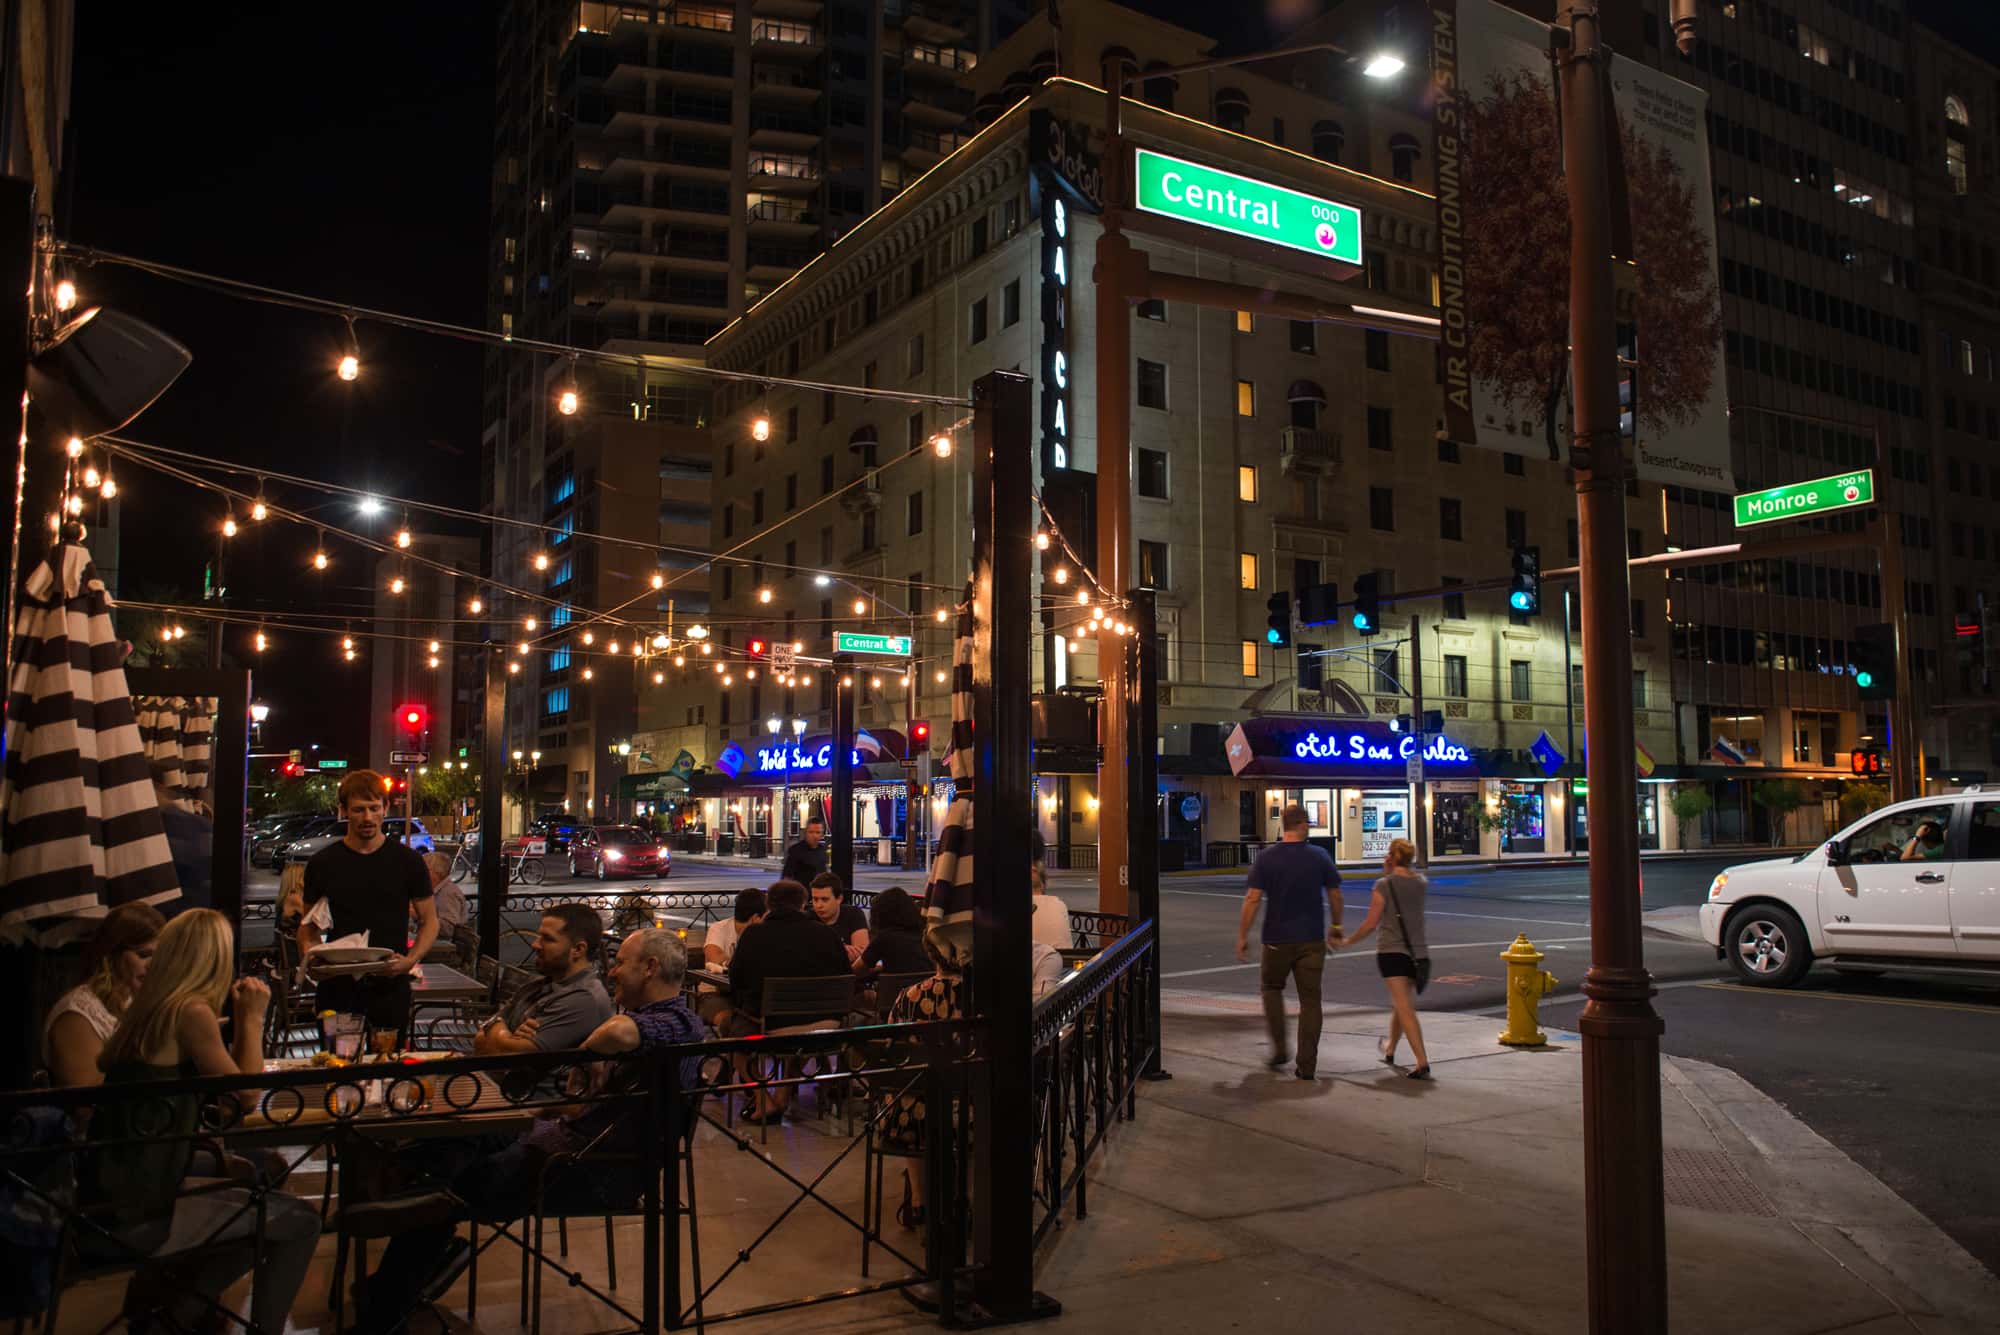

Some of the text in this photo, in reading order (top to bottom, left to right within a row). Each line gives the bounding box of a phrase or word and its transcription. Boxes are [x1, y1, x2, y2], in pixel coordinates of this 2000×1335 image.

[1048, 119, 1104, 208] Hotel
[1161, 171, 1281, 229] Central
[1434, 9, 1471, 411] AIR CONDITIONING SYSTEM
[1311, 204, 1340, 223] 000
[1054, 199, 1067, 329] SAN
[1837, 475, 1866, 488] 200 N
[1747, 491, 1819, 517] Monroe
[774, 646, 792, 656] ONE
[845, 637, 884, 650] Central
[773, 655, 793, 664] WAY
[1349, 735, 1393, 761] San
[1399, 736, 1469, 761] Crlos
[1370, 832, 1393, 841] REPAIR
